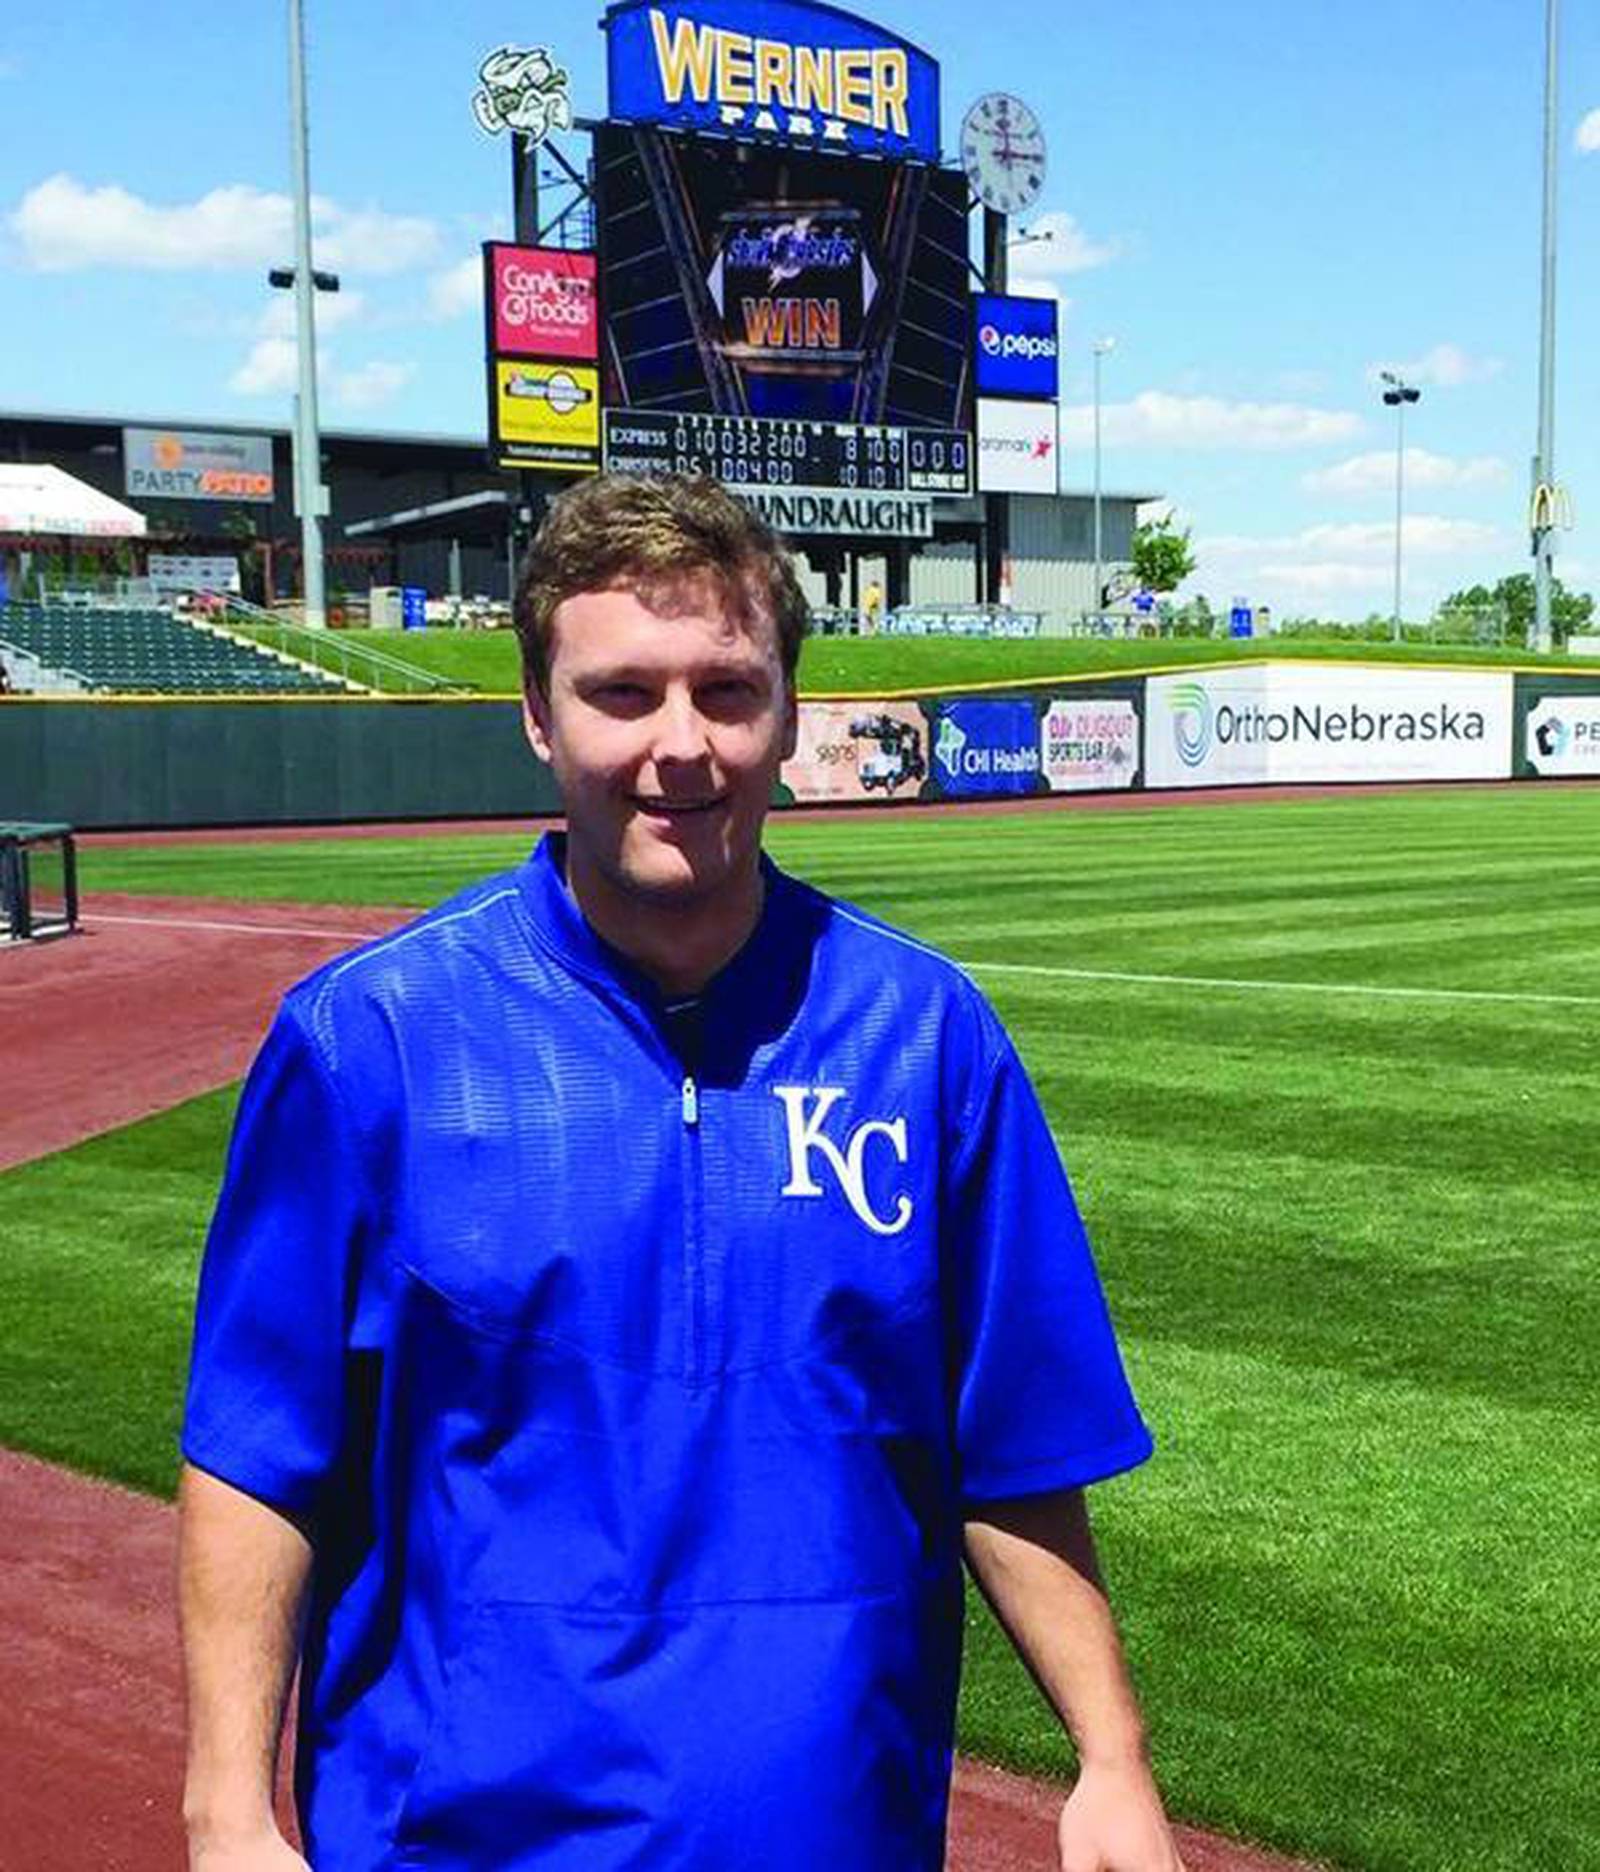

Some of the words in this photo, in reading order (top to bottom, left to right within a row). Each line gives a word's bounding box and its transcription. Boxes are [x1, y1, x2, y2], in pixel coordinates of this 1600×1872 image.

[649, 8, 909, 138] WERNER
[719, 105, 848, 140] PARK
[530, 295, 590, 325] Foods
[741, 297, 841, 348] WIN
[131, 468, 203, 494] PARTY
[743, 494, 931, 534] WNDRAUGHT
[1215, 703, 1486, 745] OrthoNebraska
[964, 748, 991, 774] CHI
[993, 746, 1040, 773] Health
[773, 1086, 913, 1235] KC
